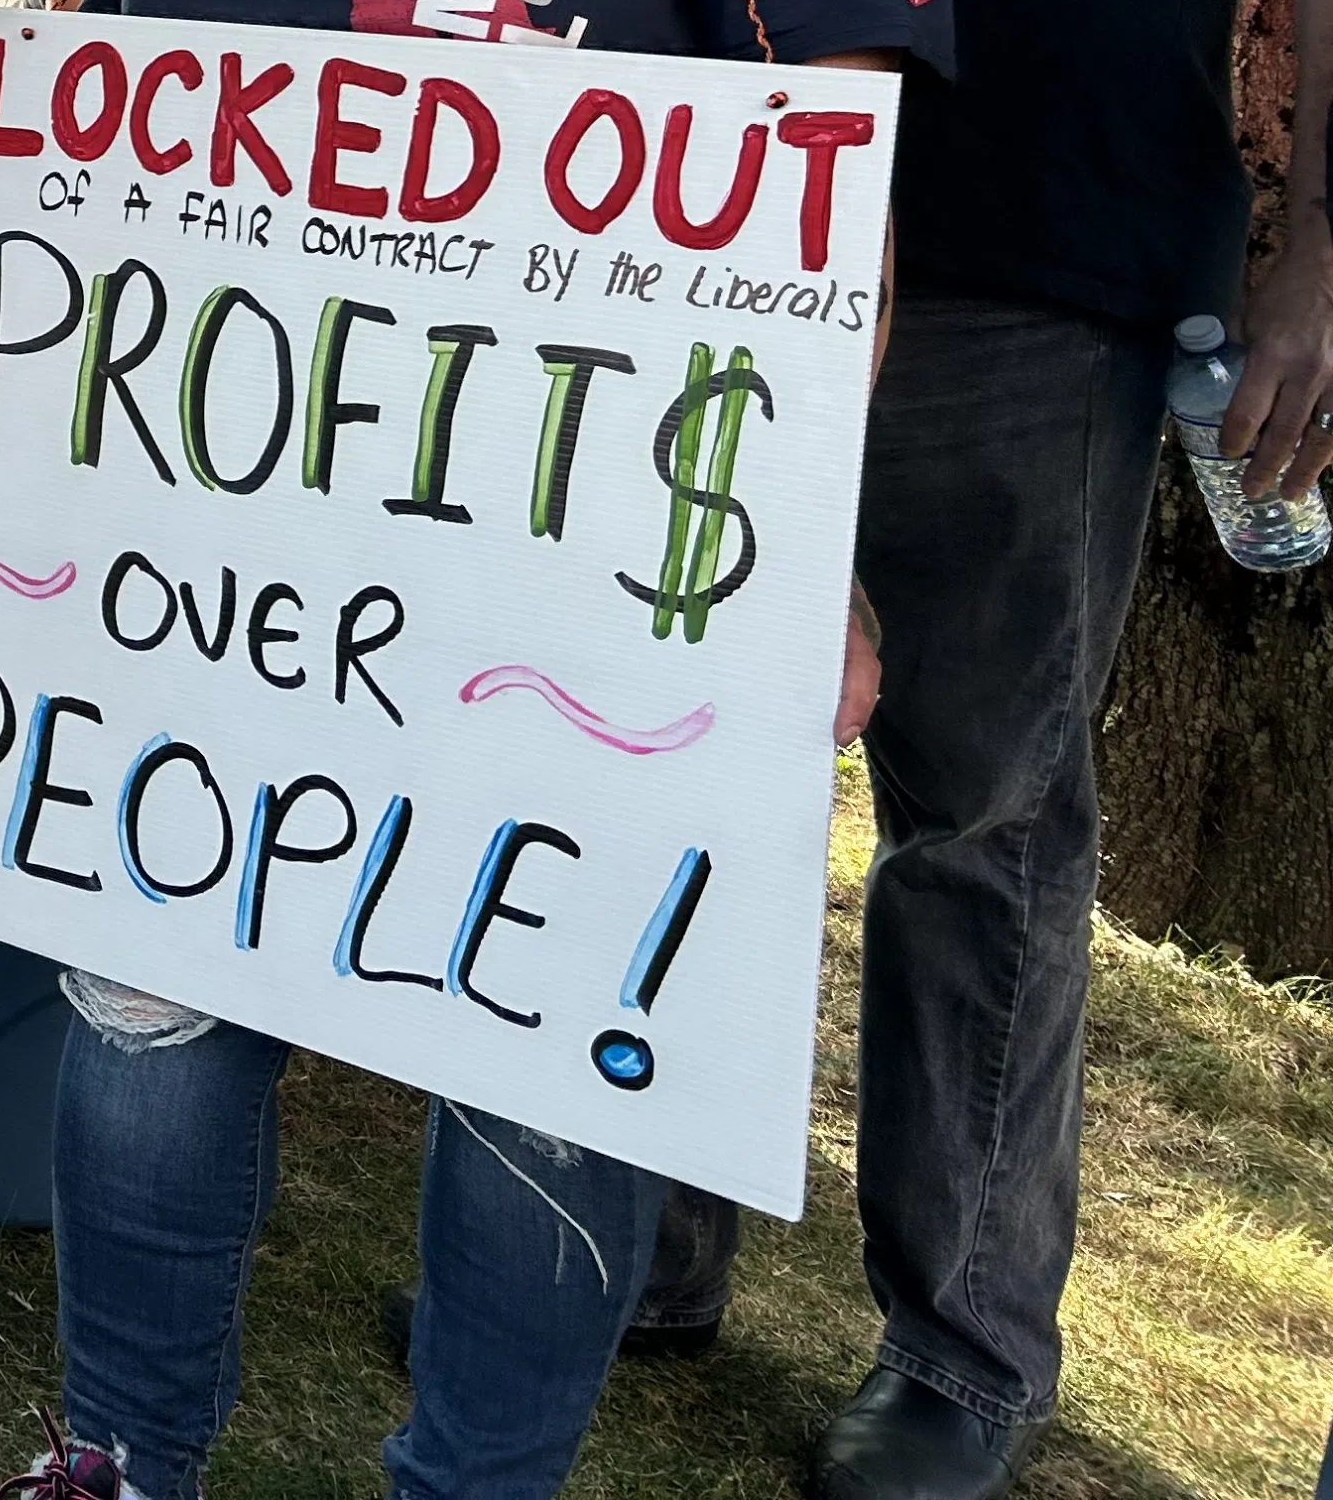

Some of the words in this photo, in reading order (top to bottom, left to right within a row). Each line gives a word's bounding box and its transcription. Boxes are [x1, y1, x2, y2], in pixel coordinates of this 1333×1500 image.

[124, 182, 151, 223] A
[178, 189, 271, 249] FAIR
[301, 216, 495, 280] CONTRACT
[523, 243, 581, 303] BY
[544, 87, 875, 272] OUT
[101, 550, 406, 727] OVER
